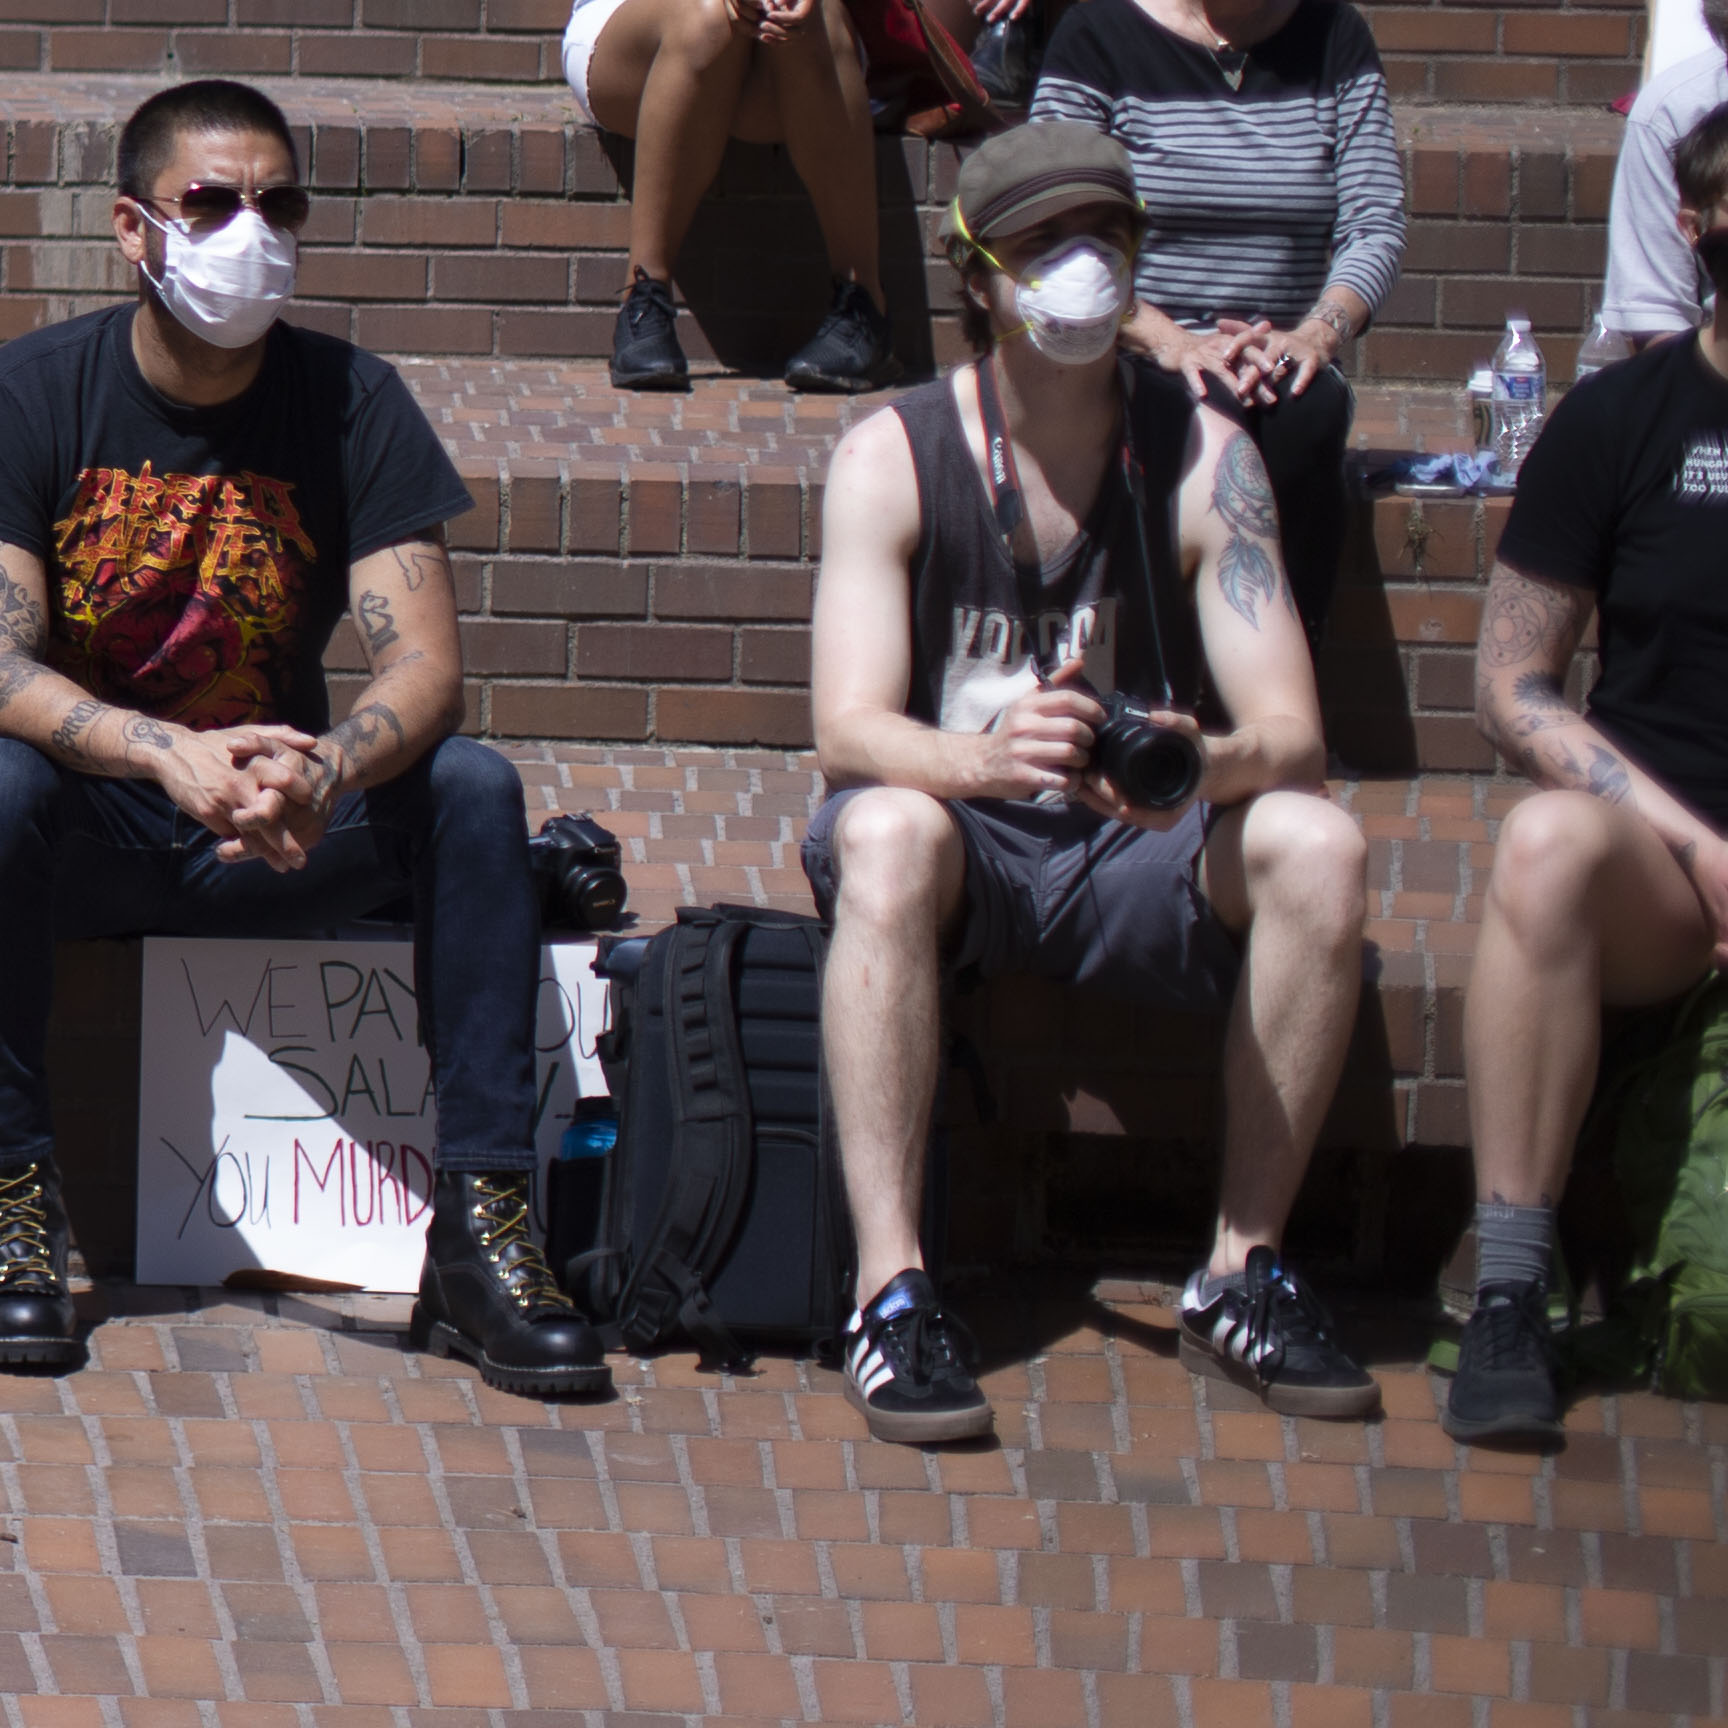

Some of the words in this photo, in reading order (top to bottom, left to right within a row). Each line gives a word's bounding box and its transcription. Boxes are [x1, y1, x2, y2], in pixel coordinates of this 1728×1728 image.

[180, 957, 307, 1039] WE
[160, 1133, 272, 1241] YOU
[292, 1137, 437, 1228] MURD
